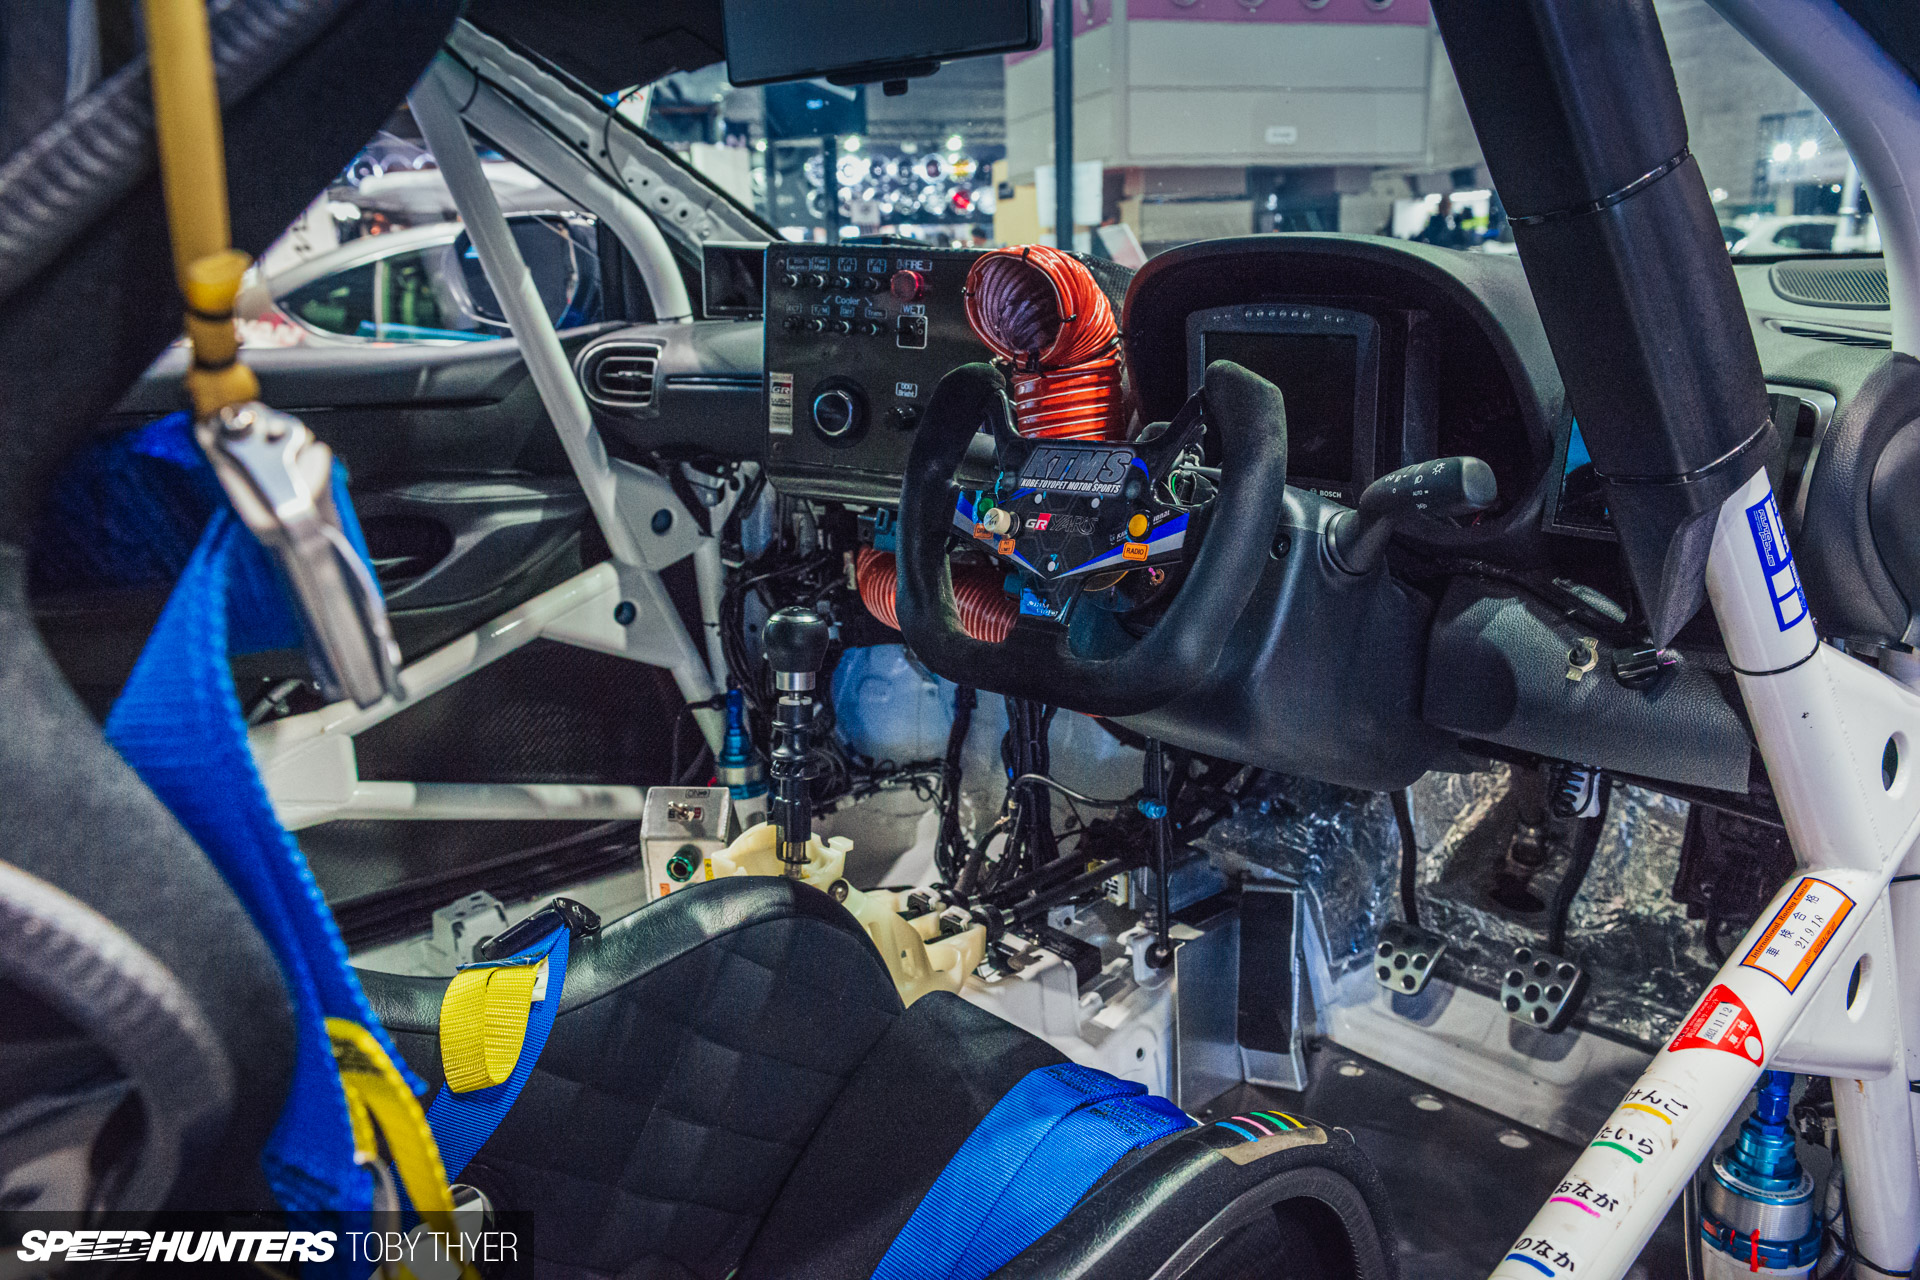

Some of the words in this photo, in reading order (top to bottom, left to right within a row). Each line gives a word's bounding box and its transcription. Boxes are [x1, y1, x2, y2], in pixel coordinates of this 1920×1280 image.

[835, 295, 860, 306] Cooler
[903, 305, 922, 314] WET
[772, 386, 790, 394] GR
[1022, 448, 1134, 484] KTMS
[1068, 481, 1092, 492] MOTOR
[1092, 483, 1121, 494] SPORTS
[1320, 490, 1342, 498] BOSCH
[1025, 518, 1048, 530] GR
[1050, 514, 1099, 536] YARIS
[1126, 546, 1145, 556] RADIO
[1750, 922, 1780, 959] International
[1778, 899, 1797, 922] Racing
[1766, 894, 1820, 957] 車検合格
[1728, 1020, 1749, 1045] 車検
[1624, 1088, 1688, 1116] けんご
[1594, 1126, 1654, 1156] たいら
[1554, 1180, 1619, 1212] おなが
[1514, 1238, 1575, 1272] のなか
